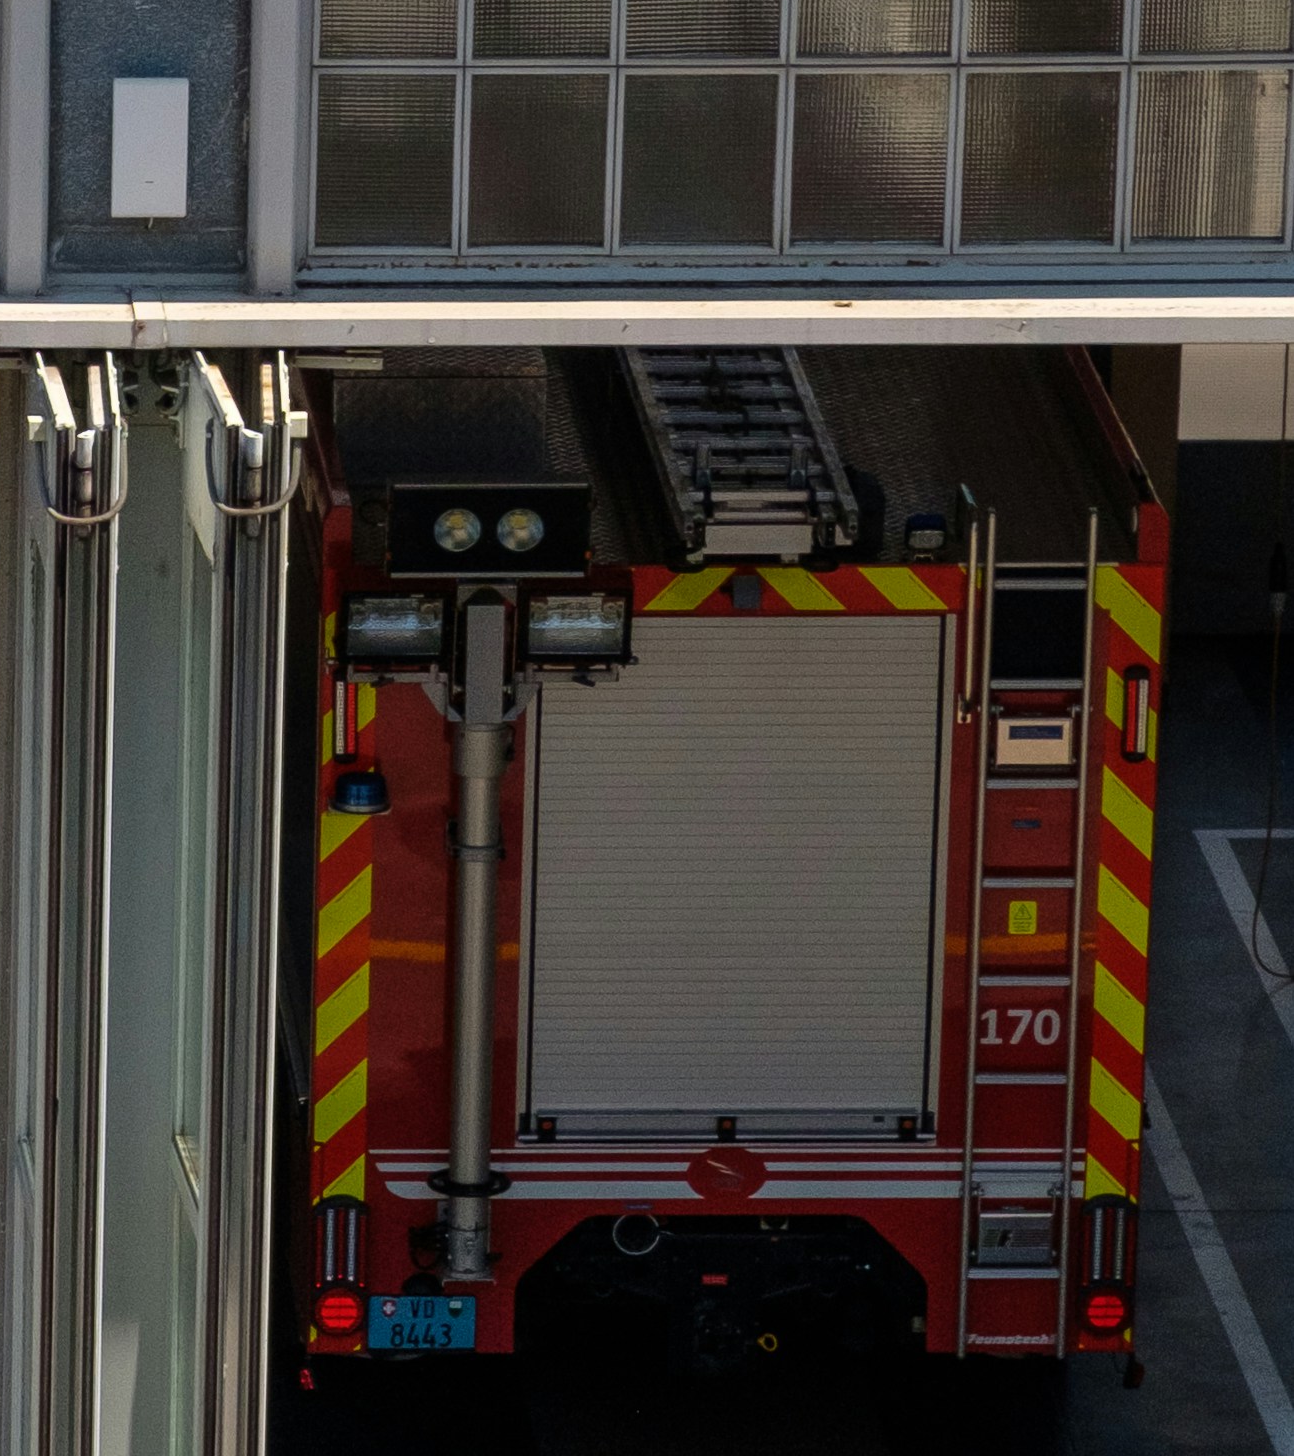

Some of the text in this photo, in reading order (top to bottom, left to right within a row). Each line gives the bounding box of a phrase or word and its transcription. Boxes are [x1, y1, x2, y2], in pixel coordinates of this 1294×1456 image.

[980, 1008, 1061, 1046] 170
[410, 1300, 435, 1318] VD
[390, 1323, 452, 1347] 8443
